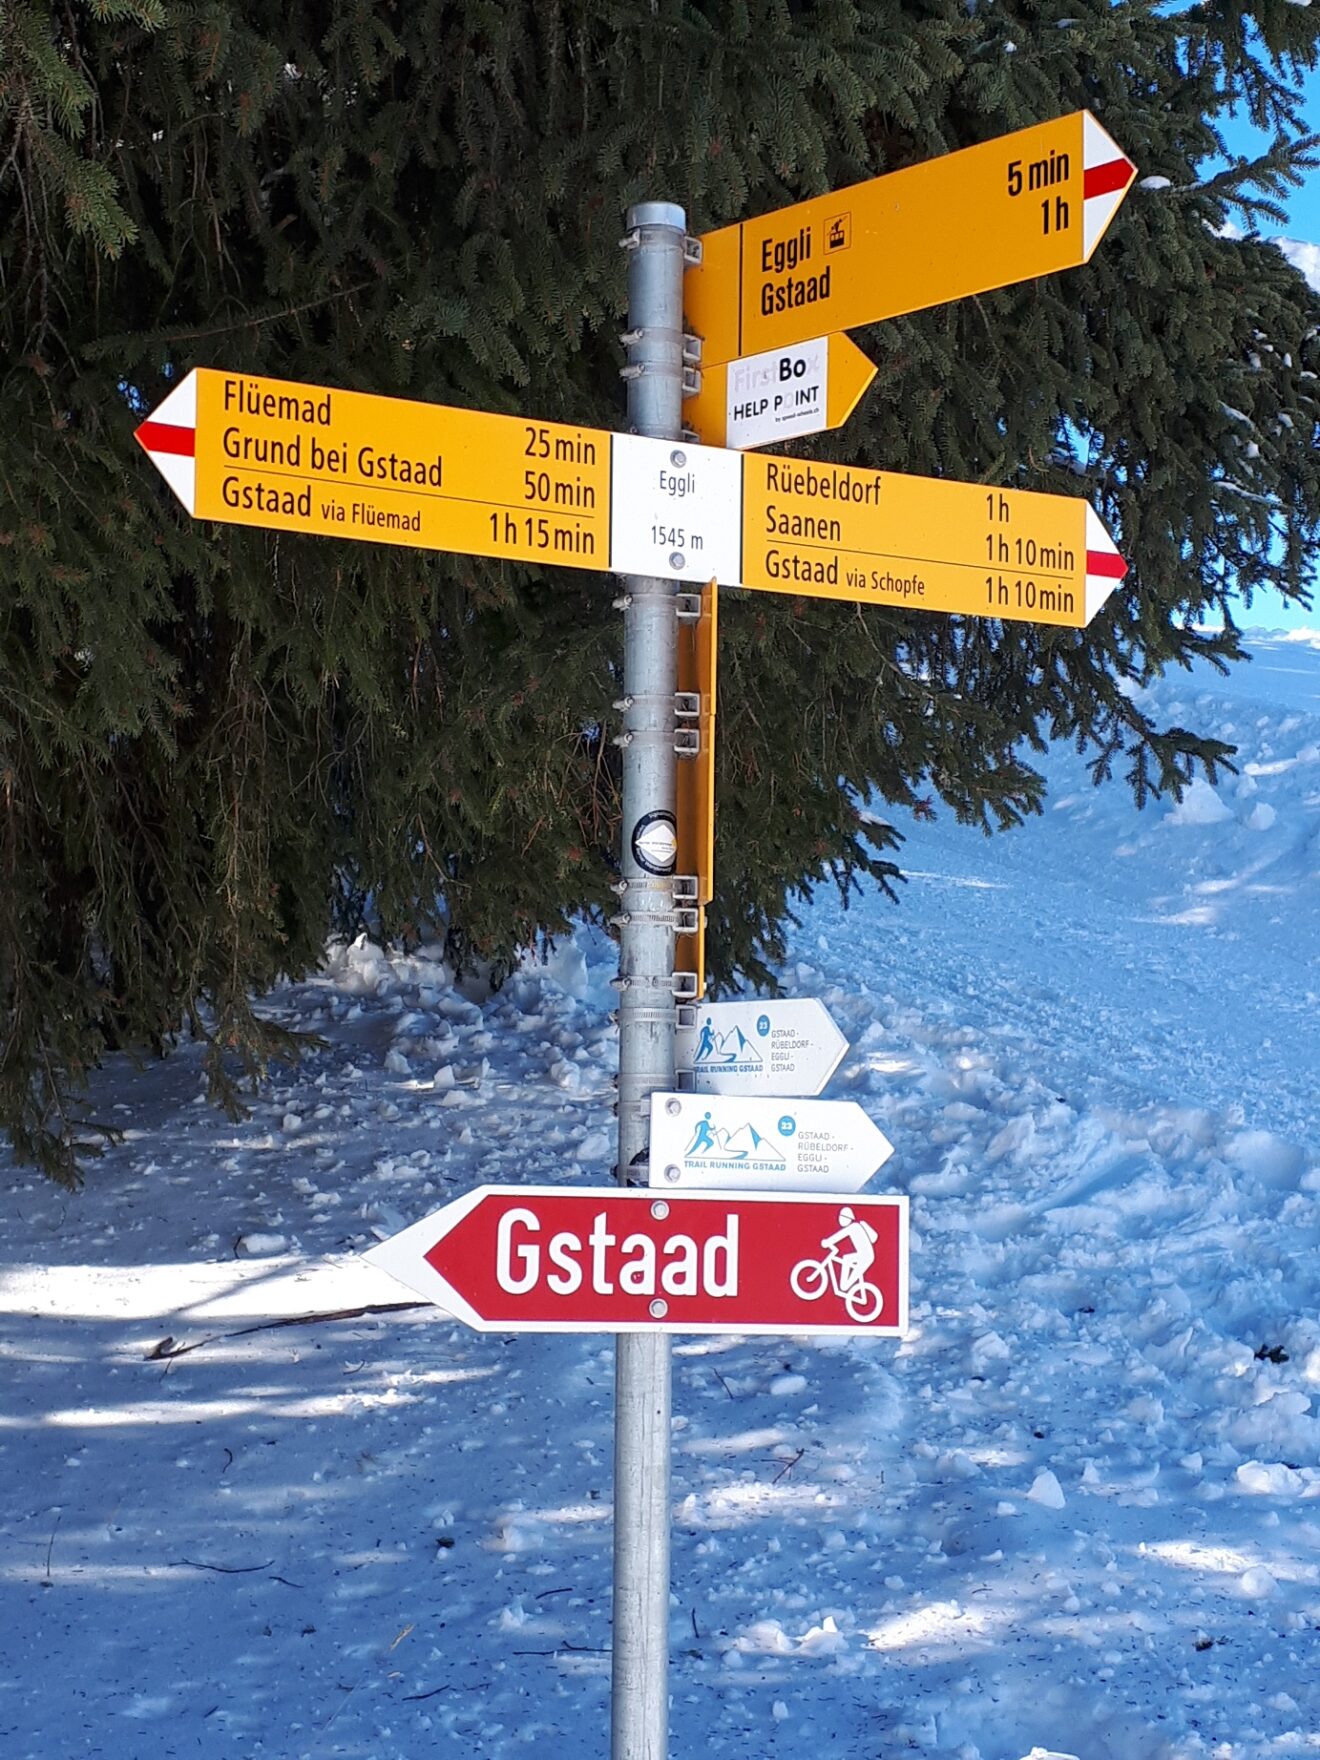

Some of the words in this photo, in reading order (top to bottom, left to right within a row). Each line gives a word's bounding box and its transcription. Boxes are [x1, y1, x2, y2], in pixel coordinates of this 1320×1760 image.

[762, 226, 811, 273] Eggli
[761, 265, 831, 316] Gstaad
[224, 380, 331, 426] Flüemad
[734, 398, 768, 421] HELP
[223, 427, 300, 467] Grund
[311, 437, 347, 473] bei
[358, 447, 442, 487] Gstaad
[659, 470, 695, 497] Eggli
[767, 463, 881, 505] Rüebeldorf
[222, 476, 311, 517] Gstaad
[321, 500, 345, 522] via
[352, 503, 421, 532] Flüemad
[766, 505, 840, 541] Saanen
[651, 525, 685, 547] 1545
[691, 534, 703, 550] m
[766, 550, 838, 585] Gstaad
[846, 568, 866, 588] via
[871, 571, 925, 598] Schopfe
[710, 1065, 737, 1073] RUNNING
[740, 1064, 763, 1072] GSTAAD
[771, 1063, 795, 1072] GSTAAD
[684, 1161, 707, 1169] TRAIL
[710, 1161, 750, 1170] RUNNING
[752, 1163, 786, 1171] GSTAAD
[797, 1165, 830, 1173] GSTAAD
[496, 1207, 739, 1298] Gstaad
